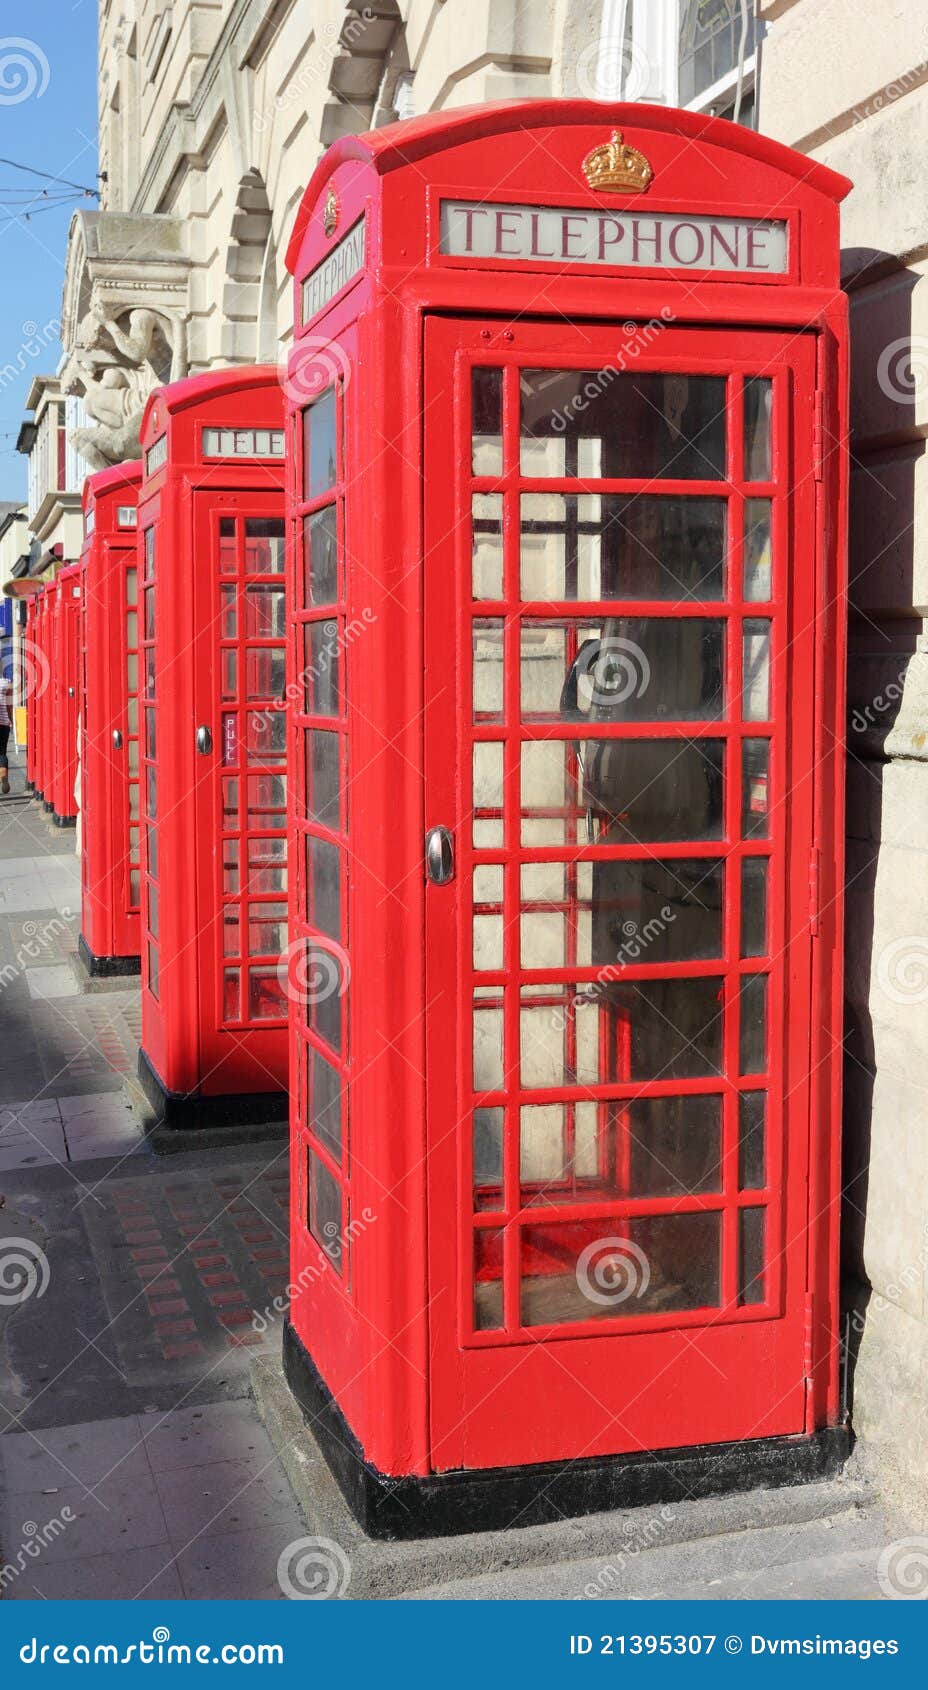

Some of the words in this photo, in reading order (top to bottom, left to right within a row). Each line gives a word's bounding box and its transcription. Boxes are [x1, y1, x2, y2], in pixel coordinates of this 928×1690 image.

[454, 207, 771, 270] TELEPHONE
[306, 222, 365, 321] TELEPHON
[227, 719, 236, 760] PULL
